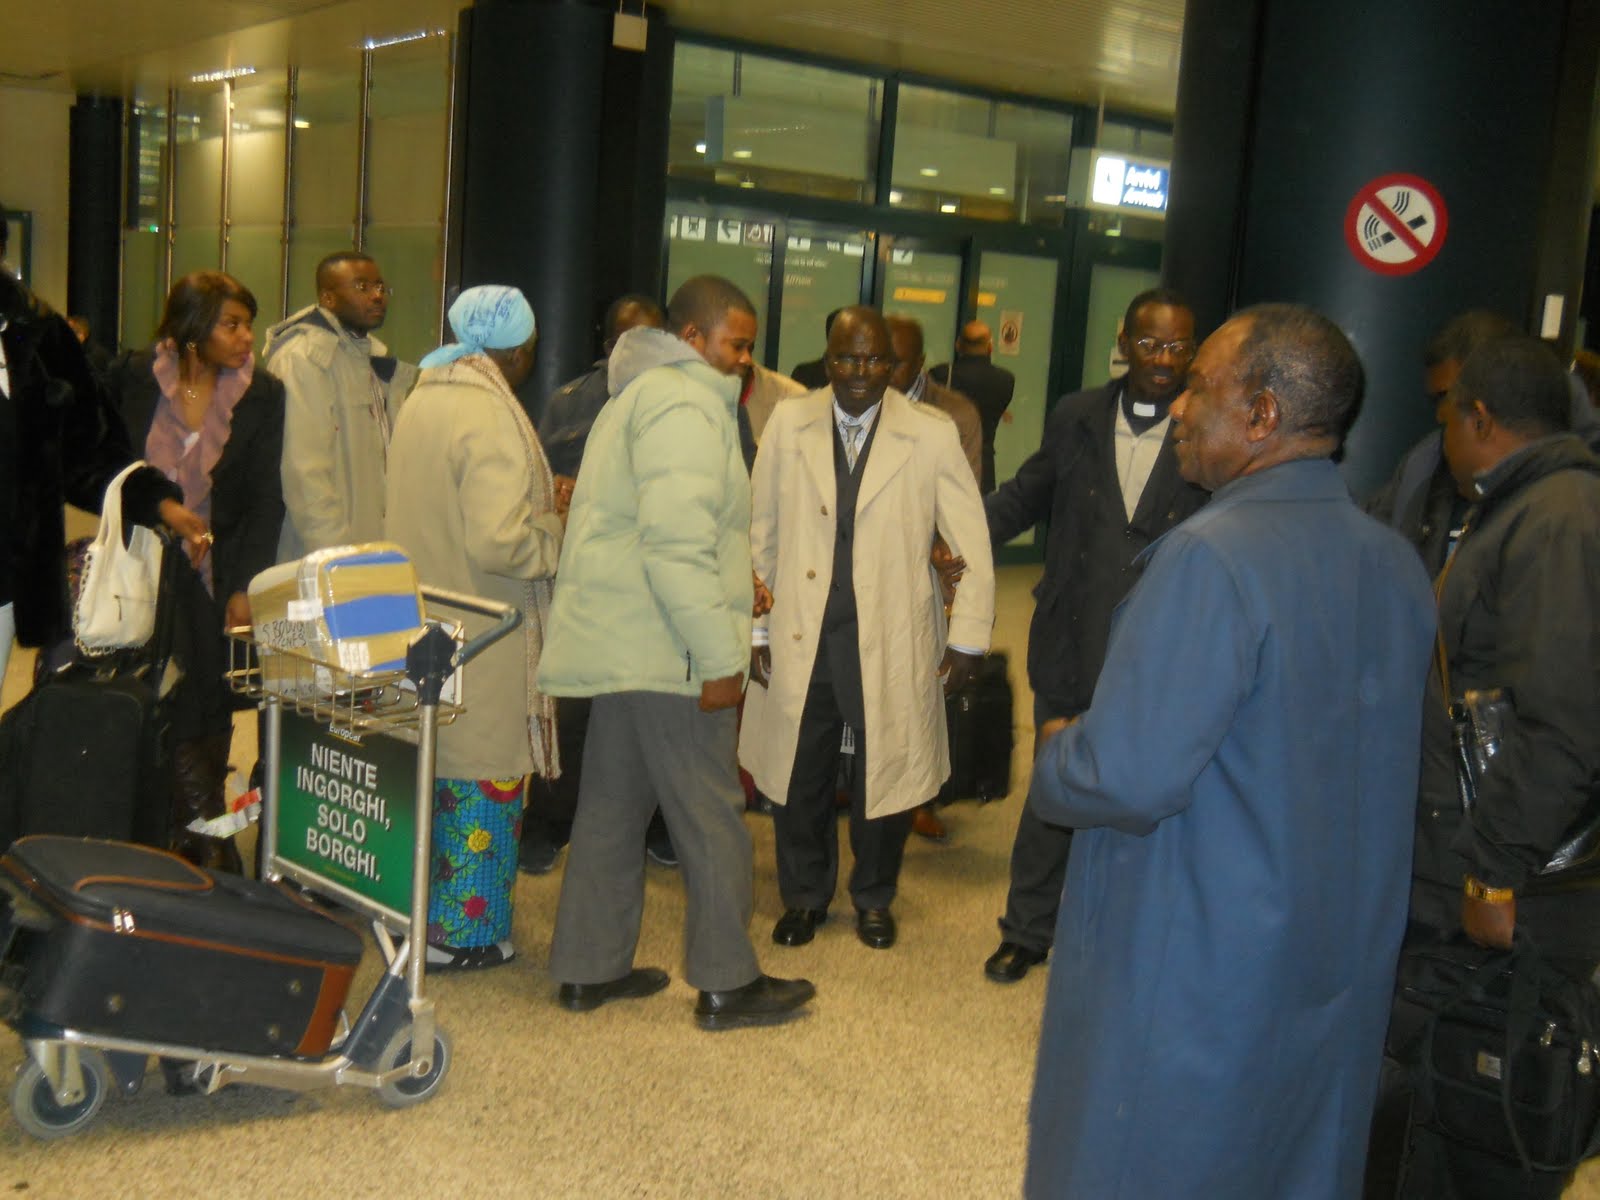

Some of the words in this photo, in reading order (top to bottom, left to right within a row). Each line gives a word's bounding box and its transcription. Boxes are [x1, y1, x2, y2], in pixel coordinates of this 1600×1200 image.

[329, 722, 361, 742] Europcar
[311, 742, 377, 790] NIENTE
[296, 765, 390, 831] INGORGHI,
[317, 803, 366, 844] SOLO
[306, 826, 380, 882] BORGHI.
